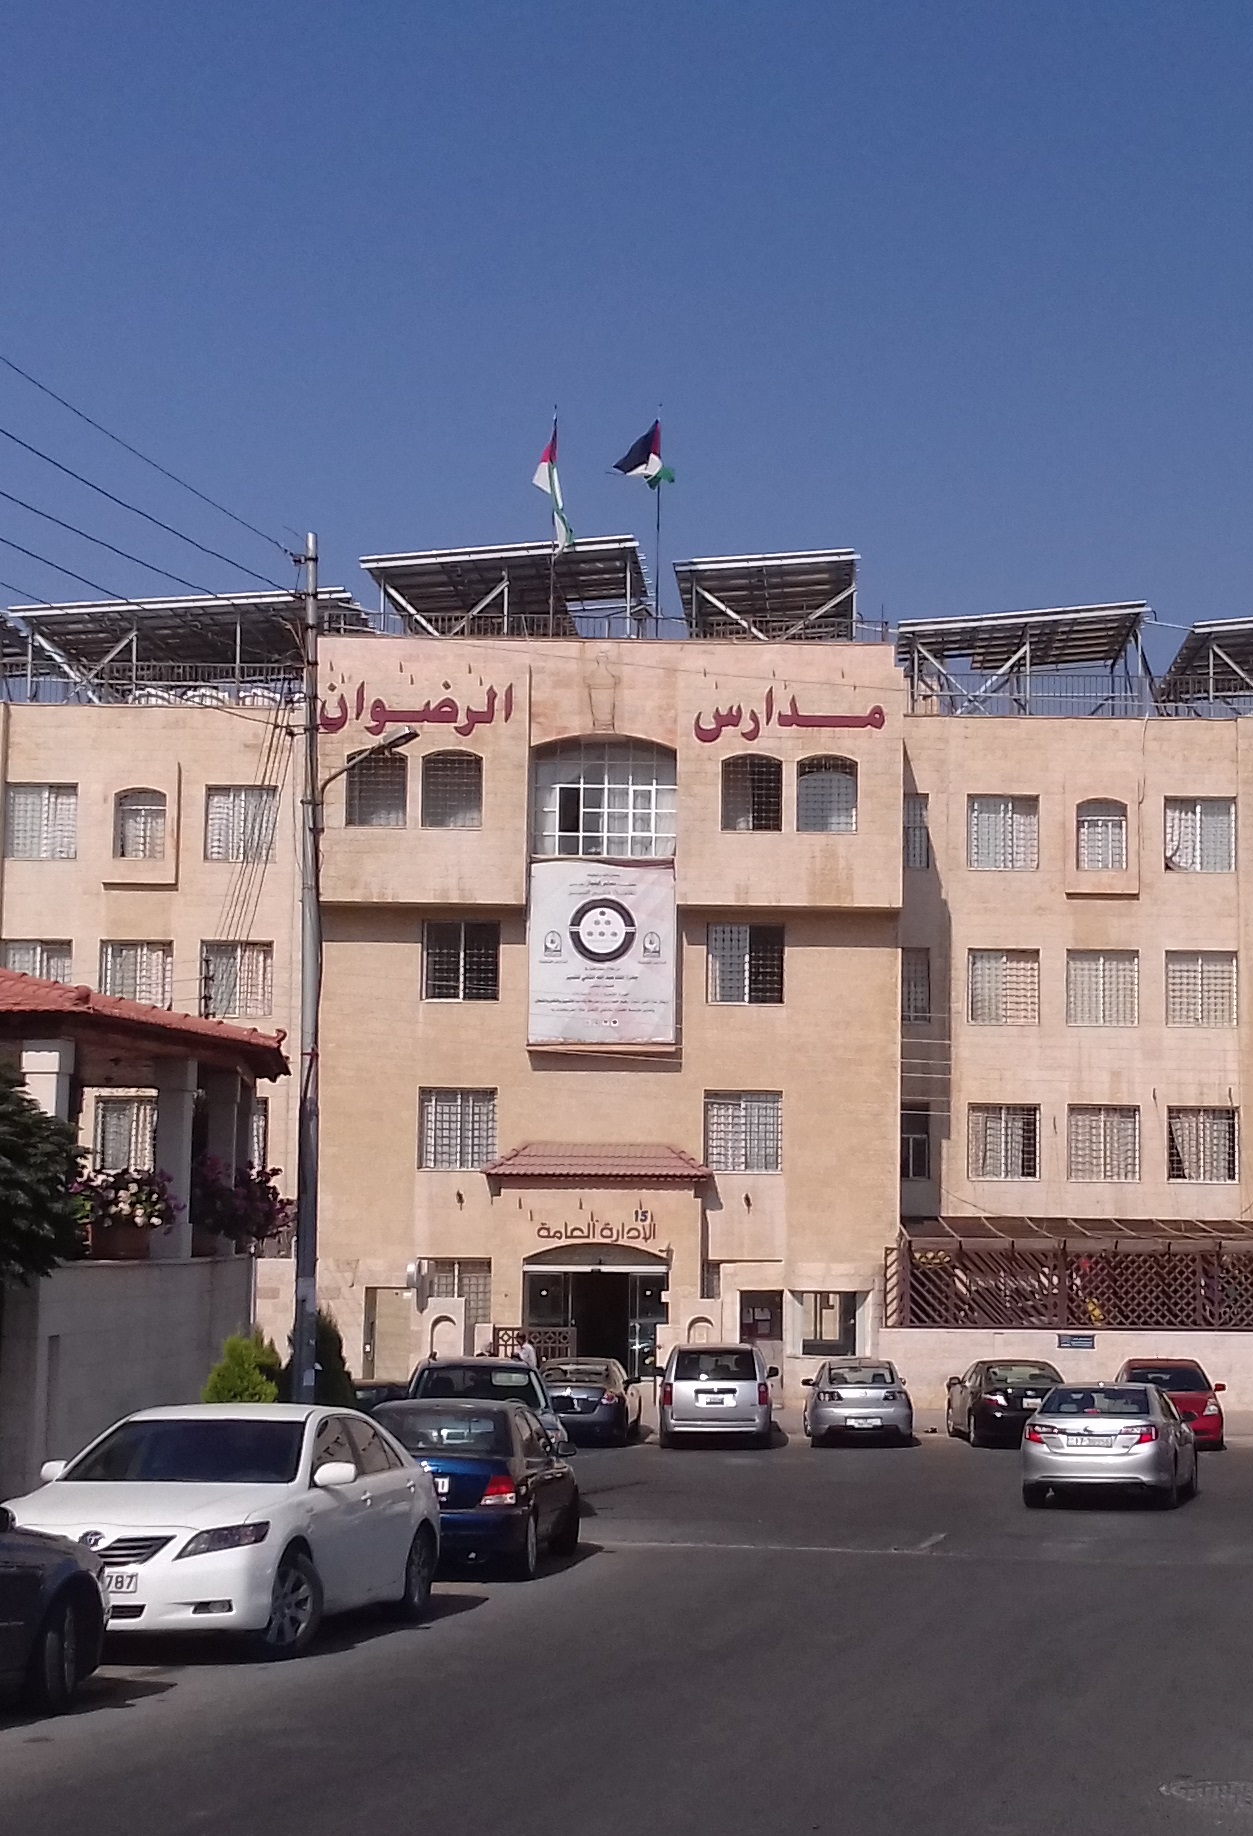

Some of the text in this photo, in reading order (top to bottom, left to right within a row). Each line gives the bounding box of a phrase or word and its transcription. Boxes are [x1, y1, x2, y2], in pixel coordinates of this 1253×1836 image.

[319, 680, 886, 742] مدارس الرضوان
[634, 1209, 649, 1222] 15
[537, 1221, 595, 1240] العامة
[106, 1574, 134, 1590] 787
